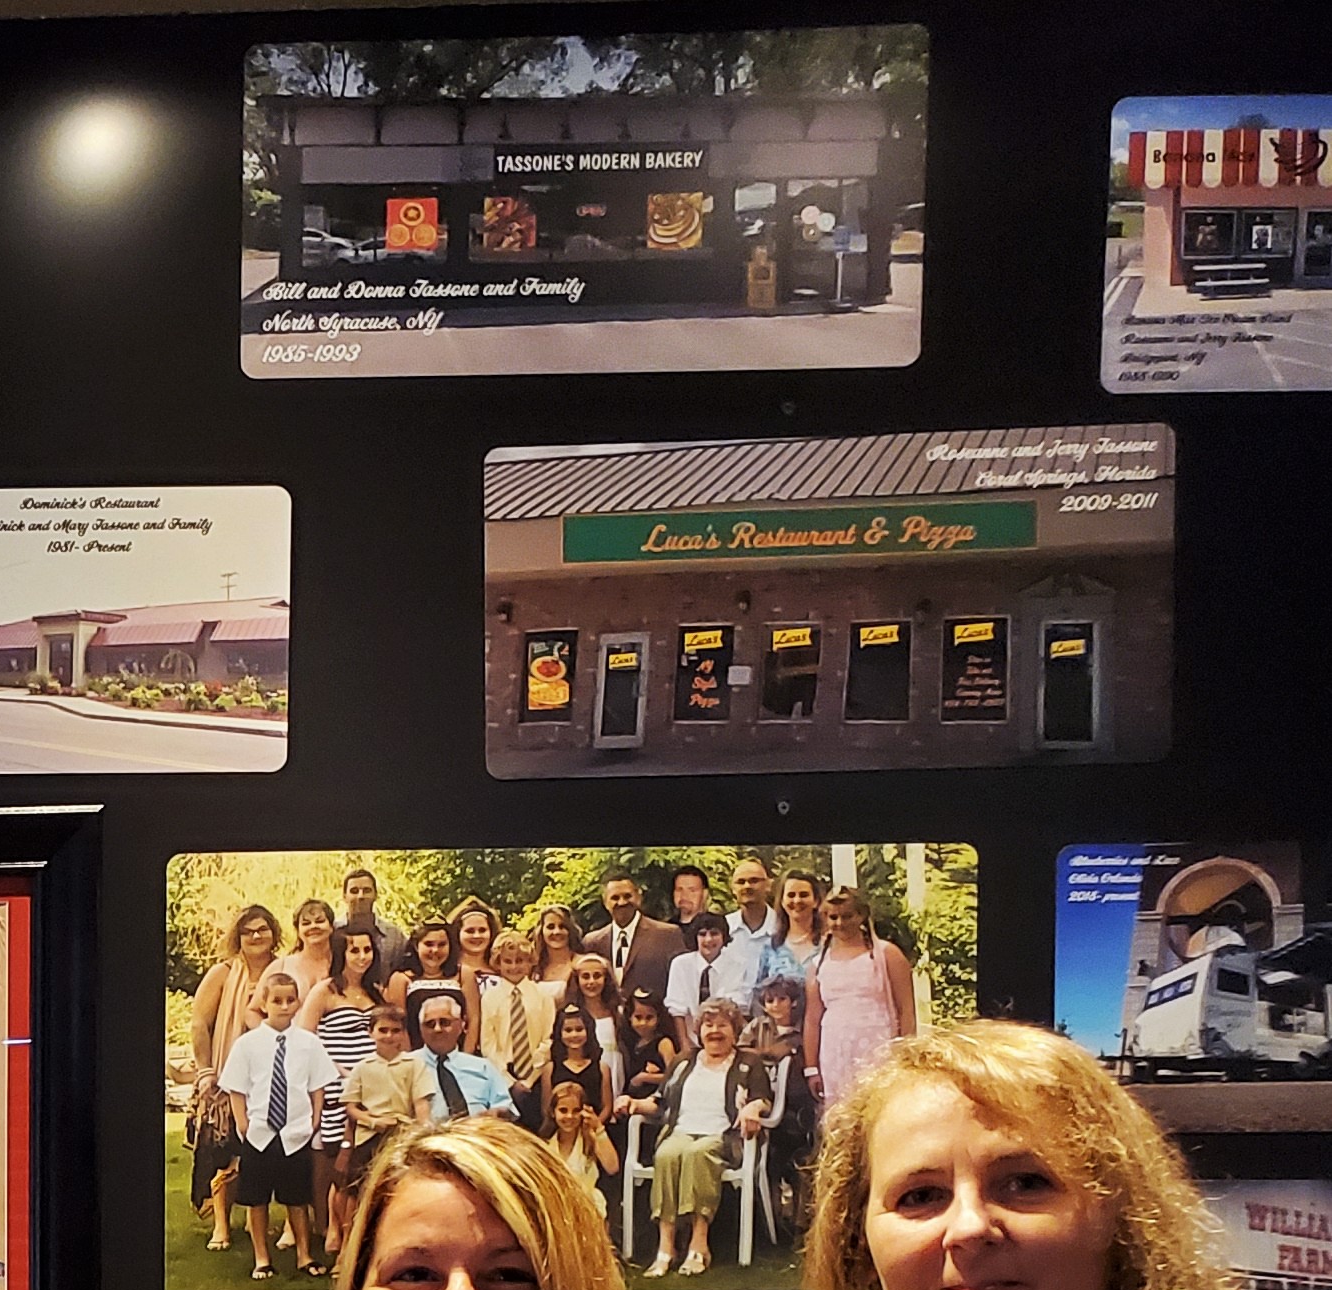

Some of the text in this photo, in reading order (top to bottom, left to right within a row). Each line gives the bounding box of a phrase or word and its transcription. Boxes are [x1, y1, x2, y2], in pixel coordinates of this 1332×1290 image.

[496, 149, 704, 173] TASSONE'S MODERN BAKERY
[263, 277, 586, 302] Bill and Donna Tassone and Family
[262, 307, 444, 339] North Syracuse, NY
[262, 343, 362, 363] 1985-1993
[926, 437, 1158, 462] Roseanne and Jerry Tassone
[975, 470, 1024, 487] Coral
[1094, 465, 1157, 482] Florida
[19, 497, 161, 511] Dominick's Restaurant
[1059, 492, 1159, 512] 2009-2011
[27, 519, 51, 531] and
[52, 519, 89, 536] Mary
[91, 518, 139, 531] Tassone
[142, 519, 166, 531] and
[167, 517, 213, 536] Family
[641, 516, 977, 552] Luca's Restaurant & Pizza
[82, 540, 132, 553] Present
